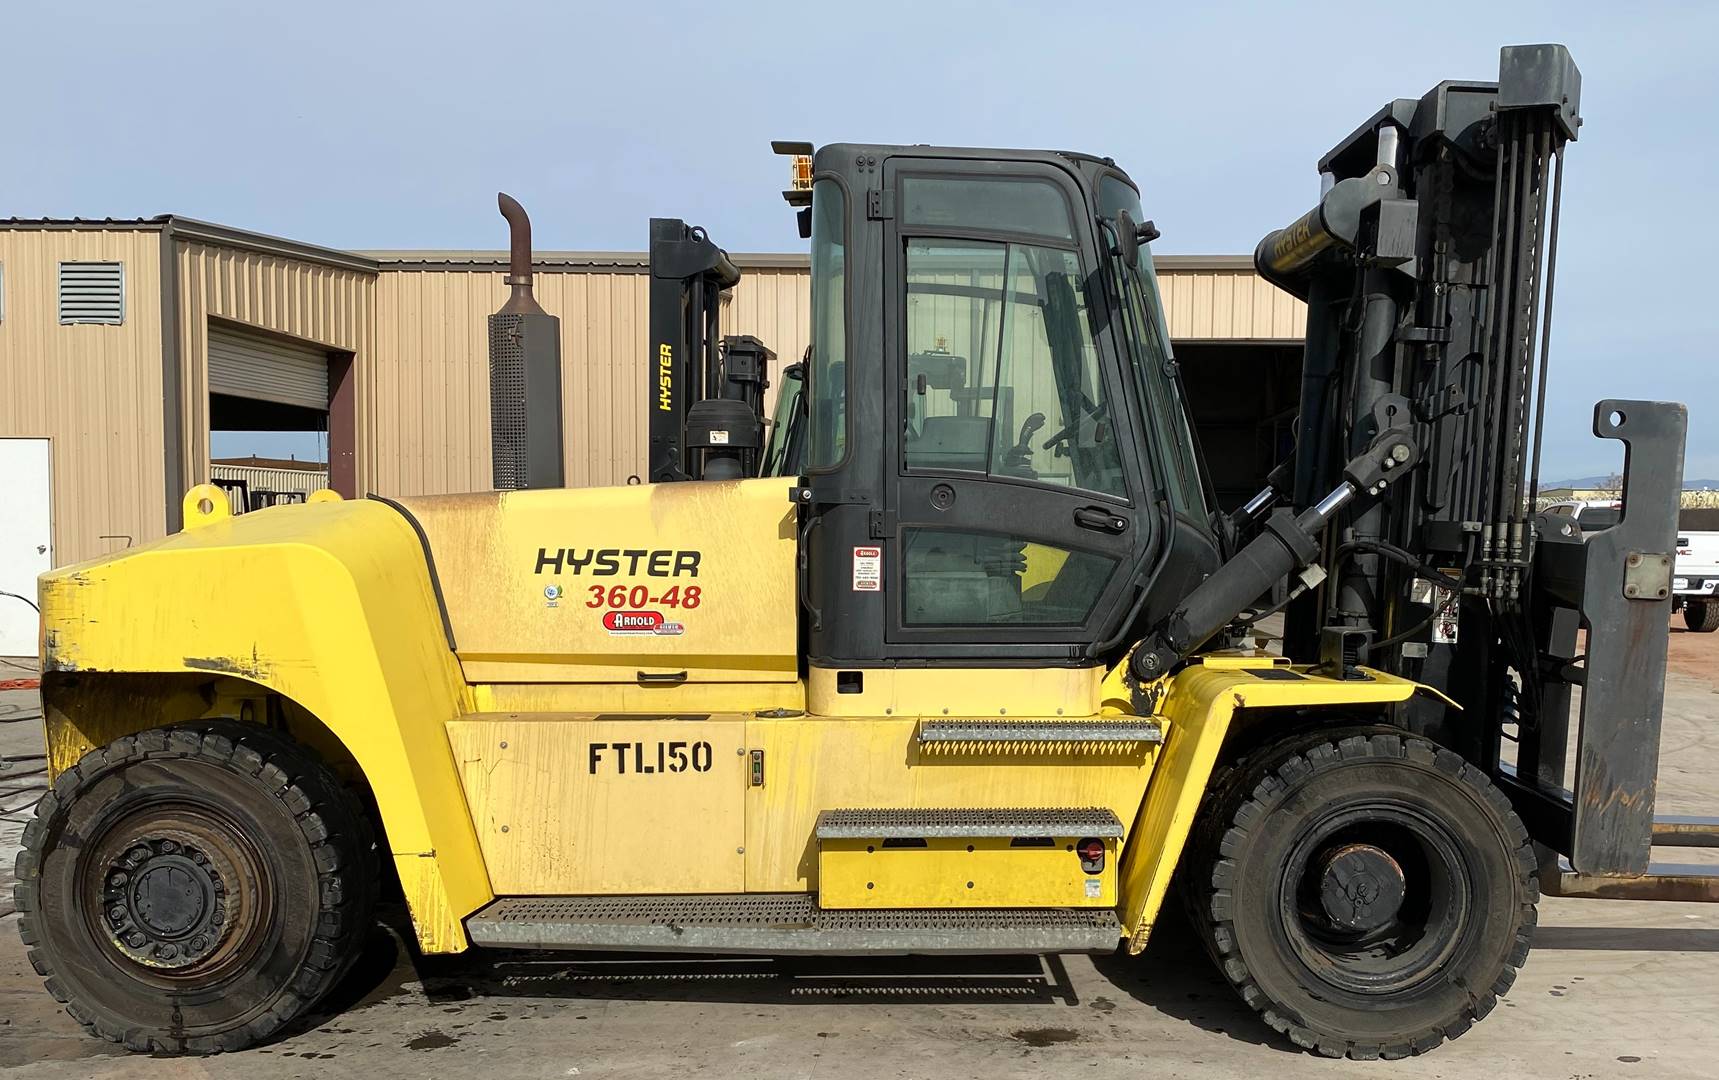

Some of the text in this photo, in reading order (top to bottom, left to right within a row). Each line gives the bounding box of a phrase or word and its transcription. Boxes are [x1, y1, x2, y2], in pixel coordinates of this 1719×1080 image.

[660, 343, 672, 411] HYSTER
[534, 548, 701, 577] HYSTER
[585, 584, 701, 609] 360-48
[589, 741, 712, 774] FTL150
